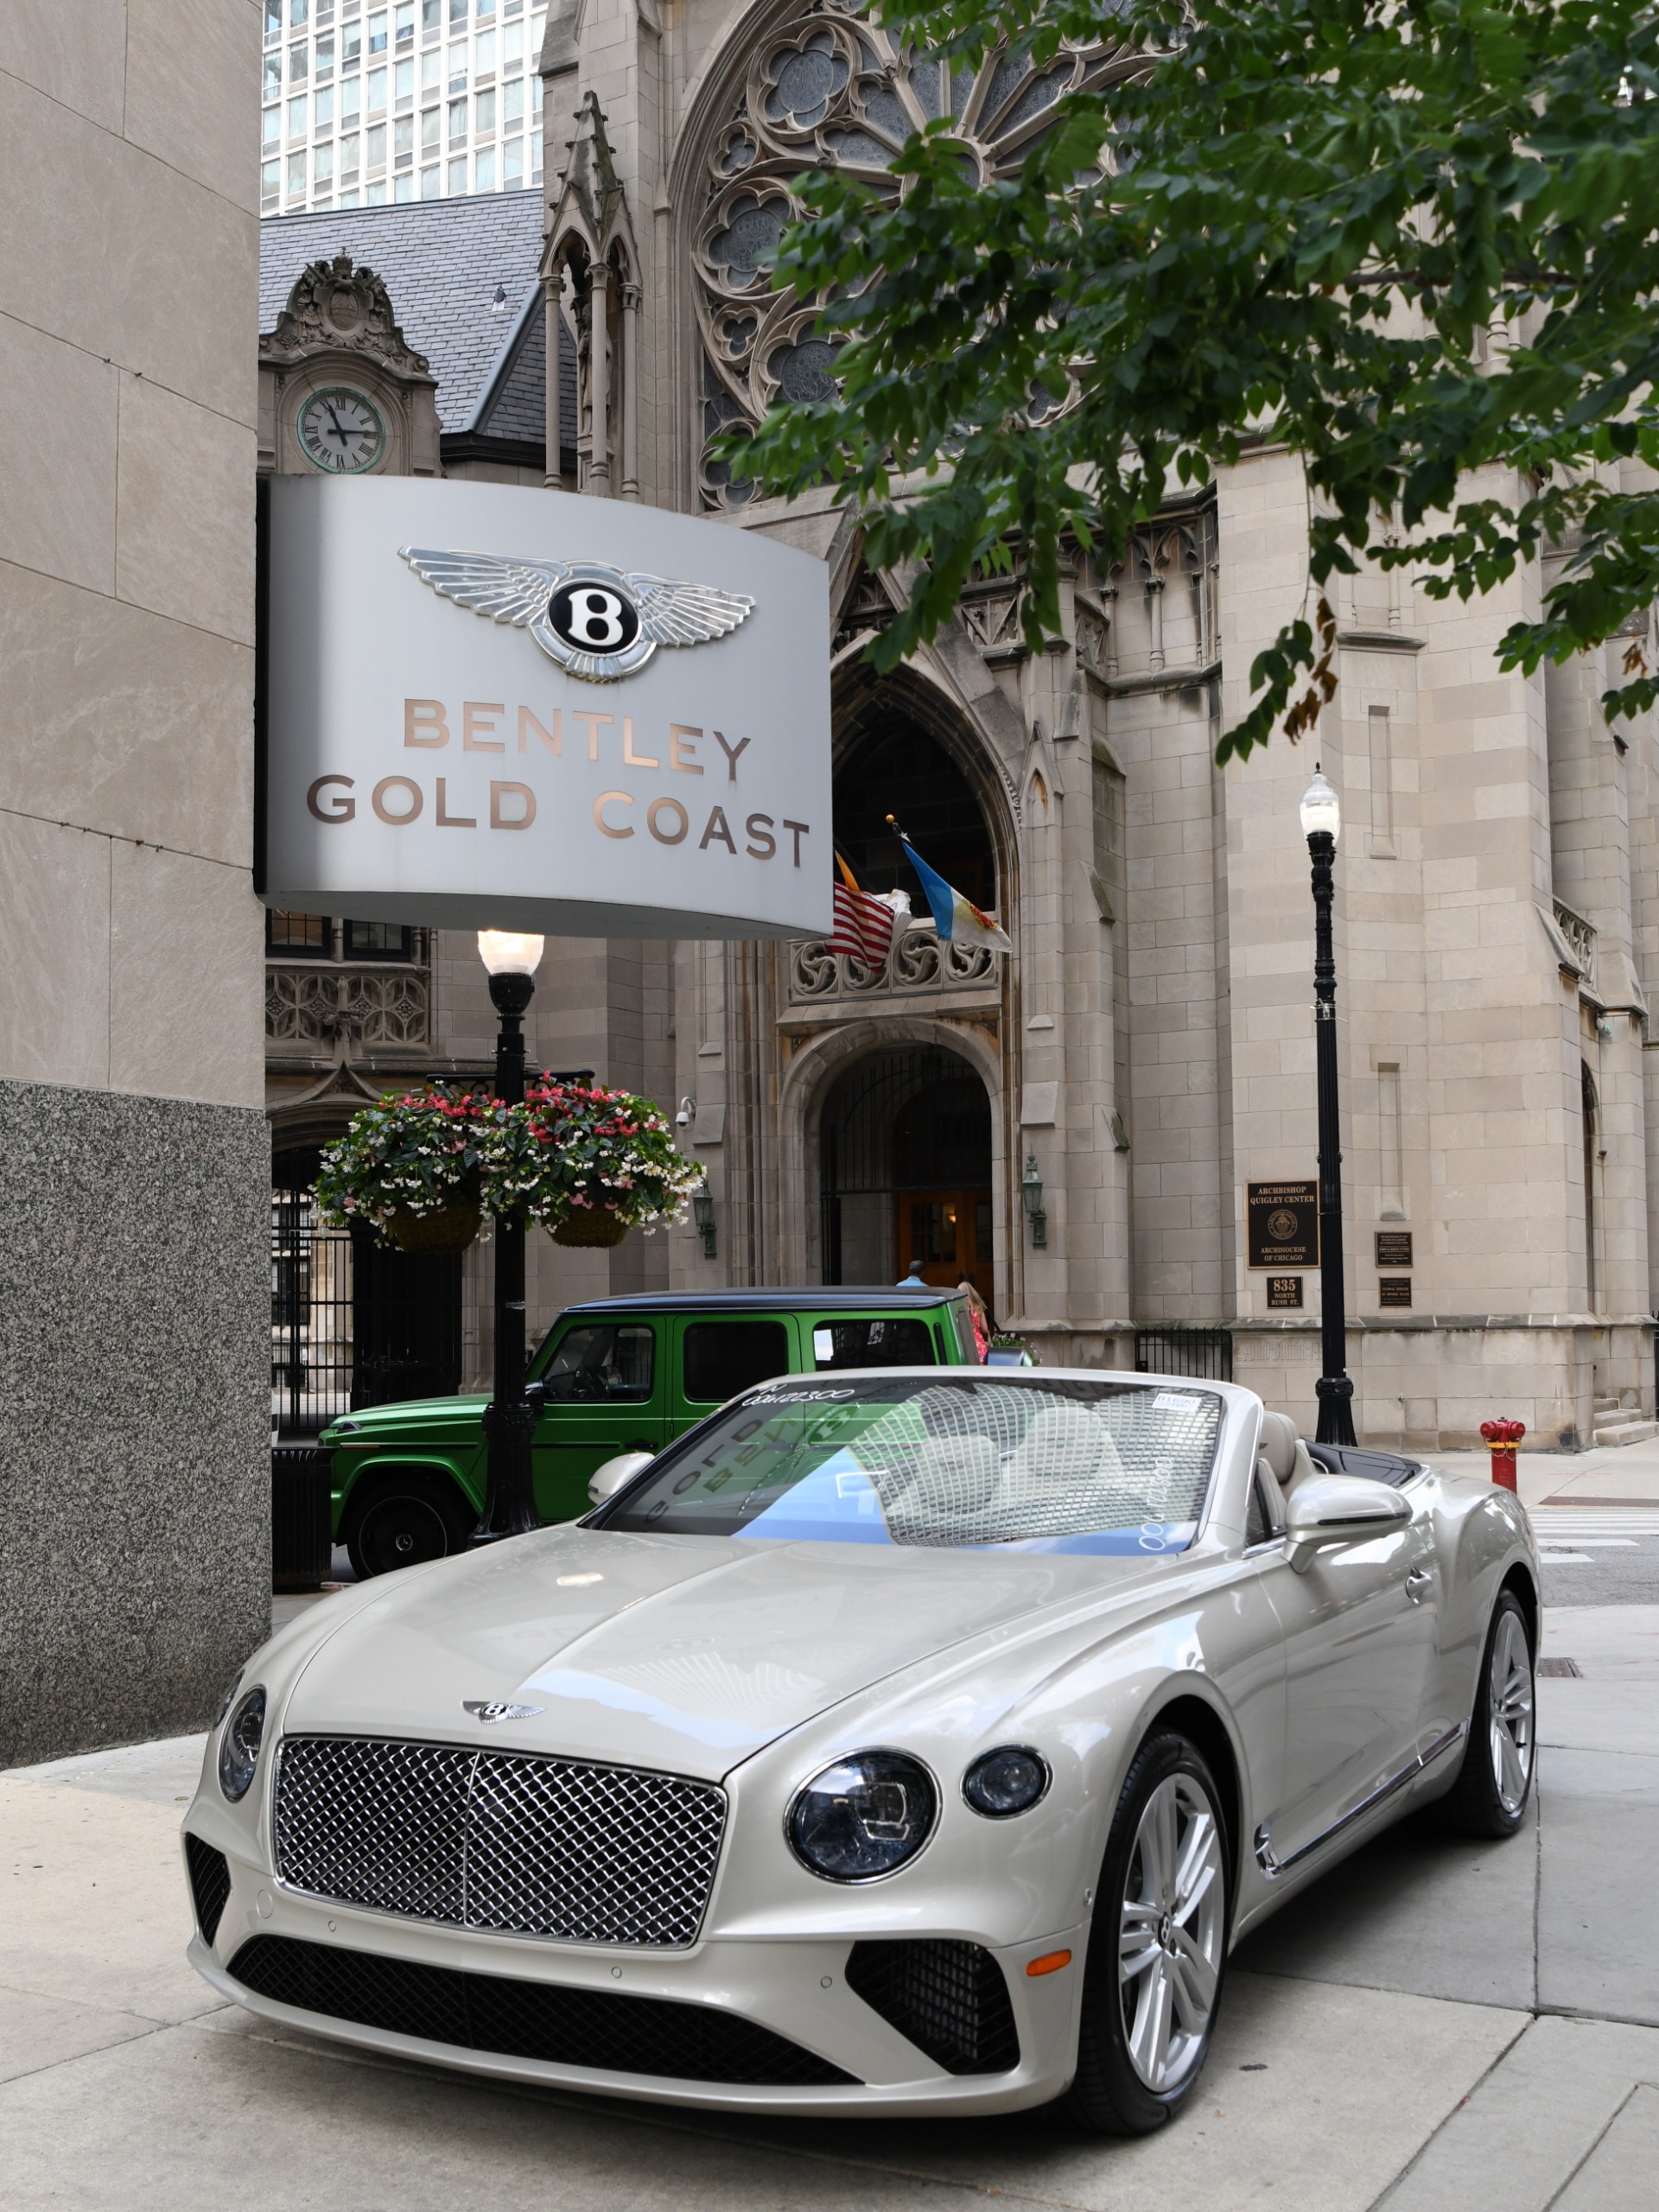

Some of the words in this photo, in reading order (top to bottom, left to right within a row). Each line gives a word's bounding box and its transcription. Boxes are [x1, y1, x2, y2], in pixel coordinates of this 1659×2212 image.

[335, 397, 346, 411] XII
[567, 588, 625, 646] B
[404, 698, 752, 780] BENTLEY
[307, 774, 537, 830] GOLD
[592, 790, 810, 868] COAST
[1273, 1279, 1296, 1292] 835
